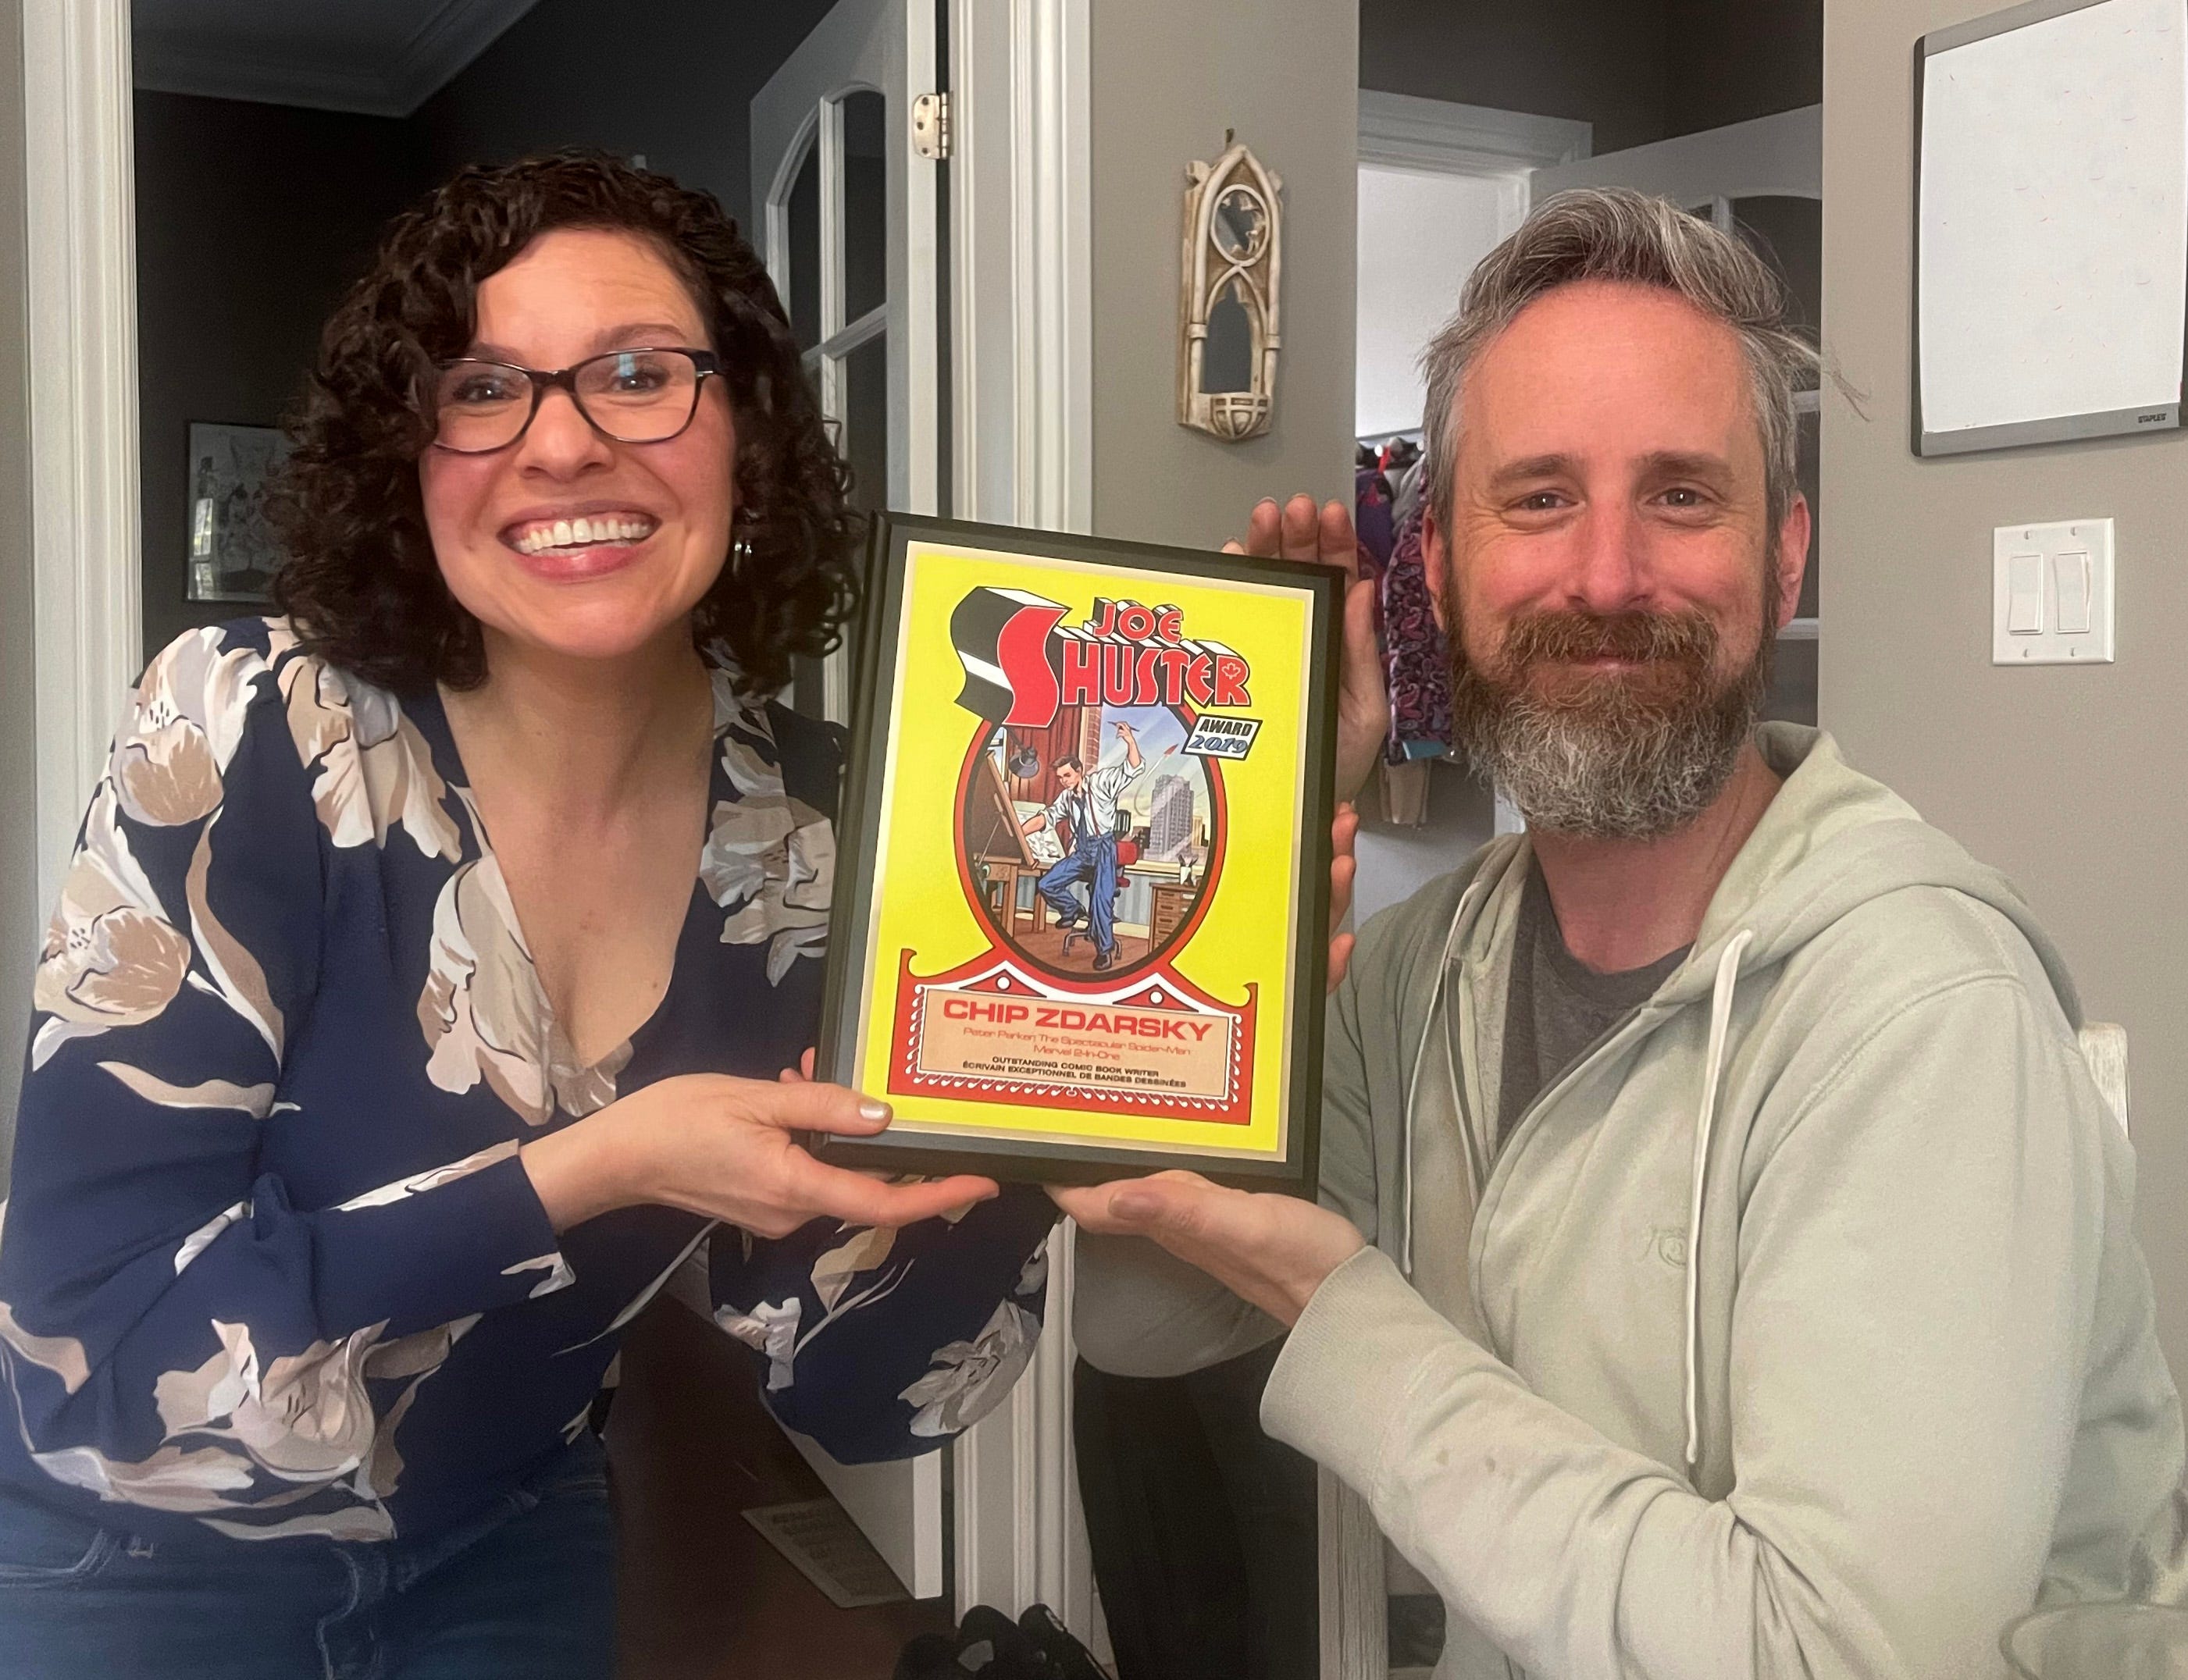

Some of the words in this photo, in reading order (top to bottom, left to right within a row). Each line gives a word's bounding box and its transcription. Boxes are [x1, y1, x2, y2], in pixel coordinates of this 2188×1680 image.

[1092, 600, 1184, 643] JOE
[995, 604, 1251, 728] SHUSTER
[1199, 718, 1253, 736] AWARD
[1188, 735, 1248, 753] 2019
[943, 999, 1029, 1023] CHIP
[1035, 1008, 1213, 1041] ZDARSKY
[962, 1060, 1005, 1072] ÉCRIVAIN
[1007, 1066, 1077, 1079] EXCEPTIONNEL
[1094, 1074, 1132, 1084] BANDES
[1135, 1077, 1187, 1088] DESSINÉES
[992, 1055, 1058, 1069] OUTSTANDING
[1060, 1062, 1093, 1072] COMIC
[1096, 1066, 1122, 1074] BOOK
[1124, 1067, 1160, 1077] WRITER
